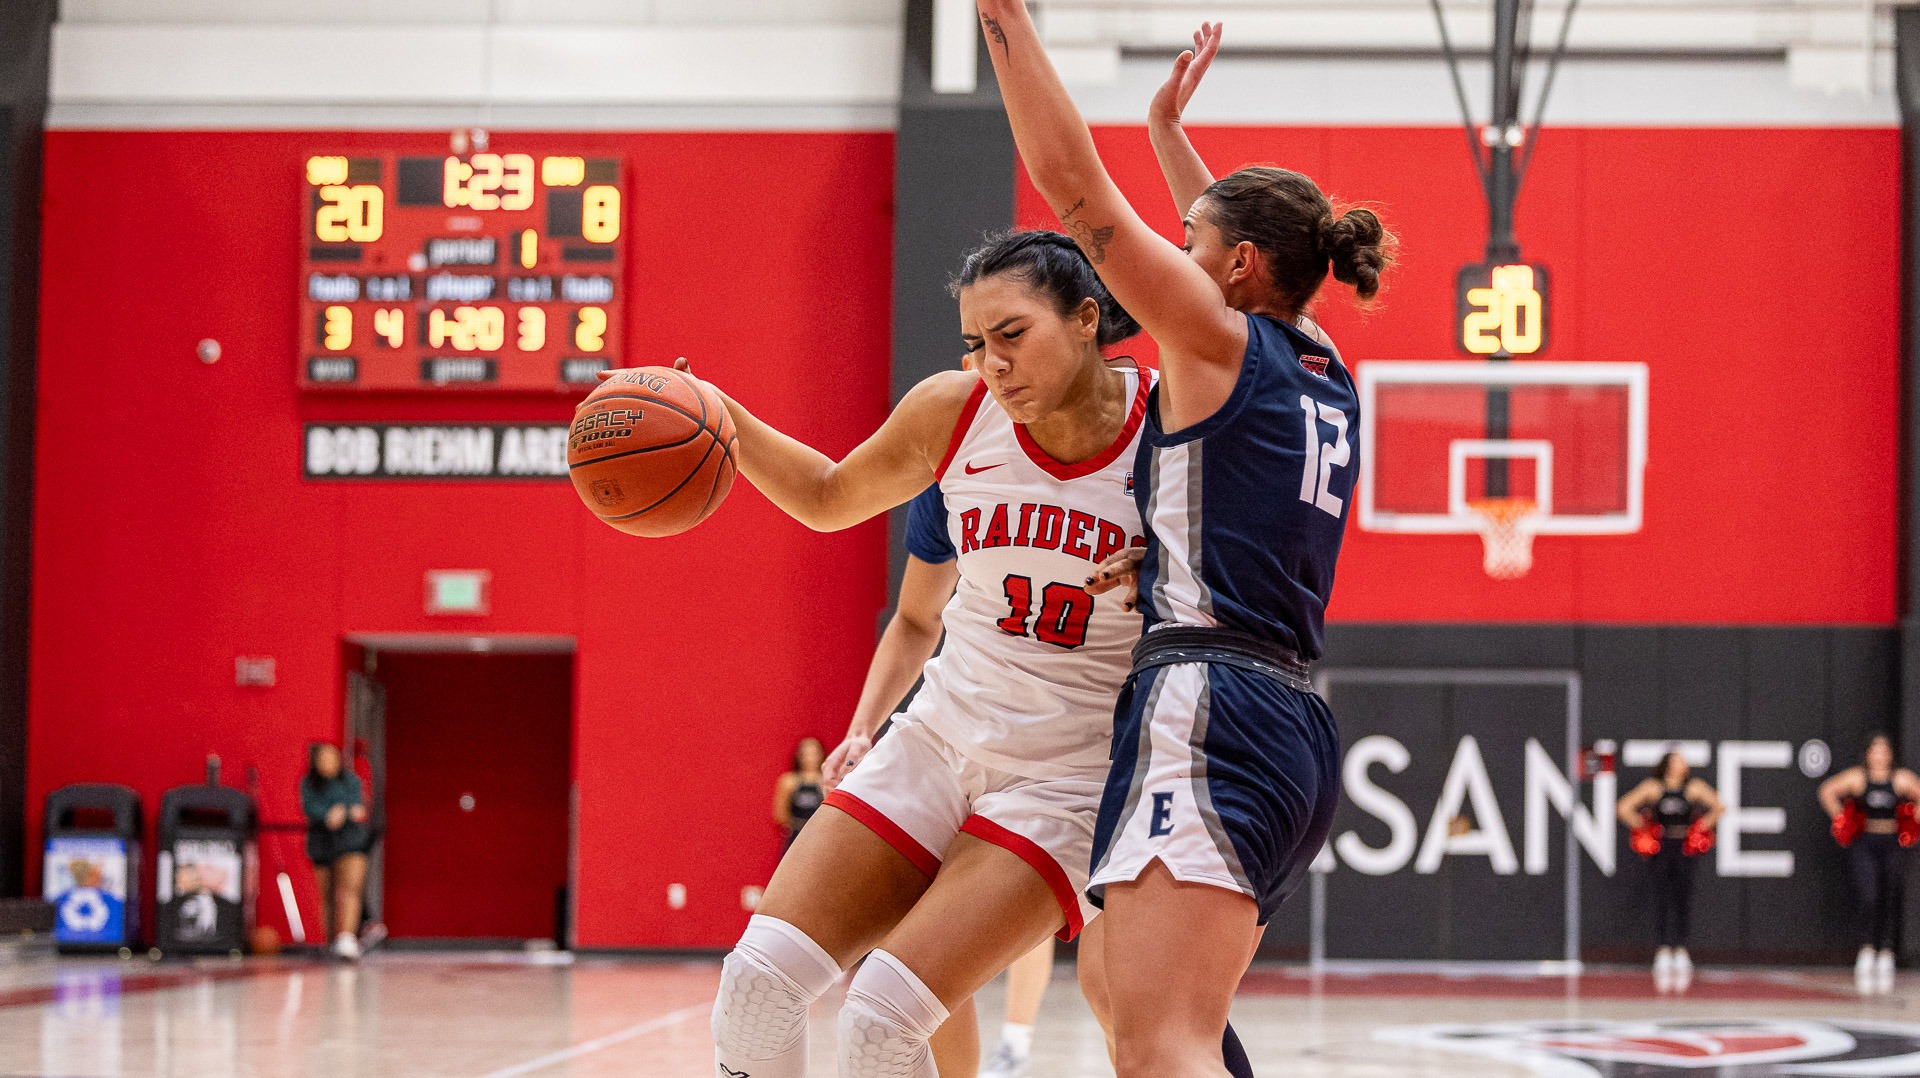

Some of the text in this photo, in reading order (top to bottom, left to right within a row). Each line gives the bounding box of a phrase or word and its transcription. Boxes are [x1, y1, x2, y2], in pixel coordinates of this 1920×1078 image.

[316, 185, 384, 242] 20
[582, 185, 620, 243] 8
[521, 228, 538, 269] 1
[325, 305, 352, 351] 3
[374, 308, 404, 348] 4
[517, 306, 546, 351] 3
[575, 306, 607, 352] 2
[1464, 288, 1542, 353] 20
[569, 409, 645, 440] LEGACY
[581, 428, 633, 444] 1000
[308, 427, 379, 474] BOB
[1299, 394, 1350, 519] 12
[997, 573, 1094, 650] 10
[1148, 791, 1175, 839] E
[1308, 734, 1796, 877] SANE
